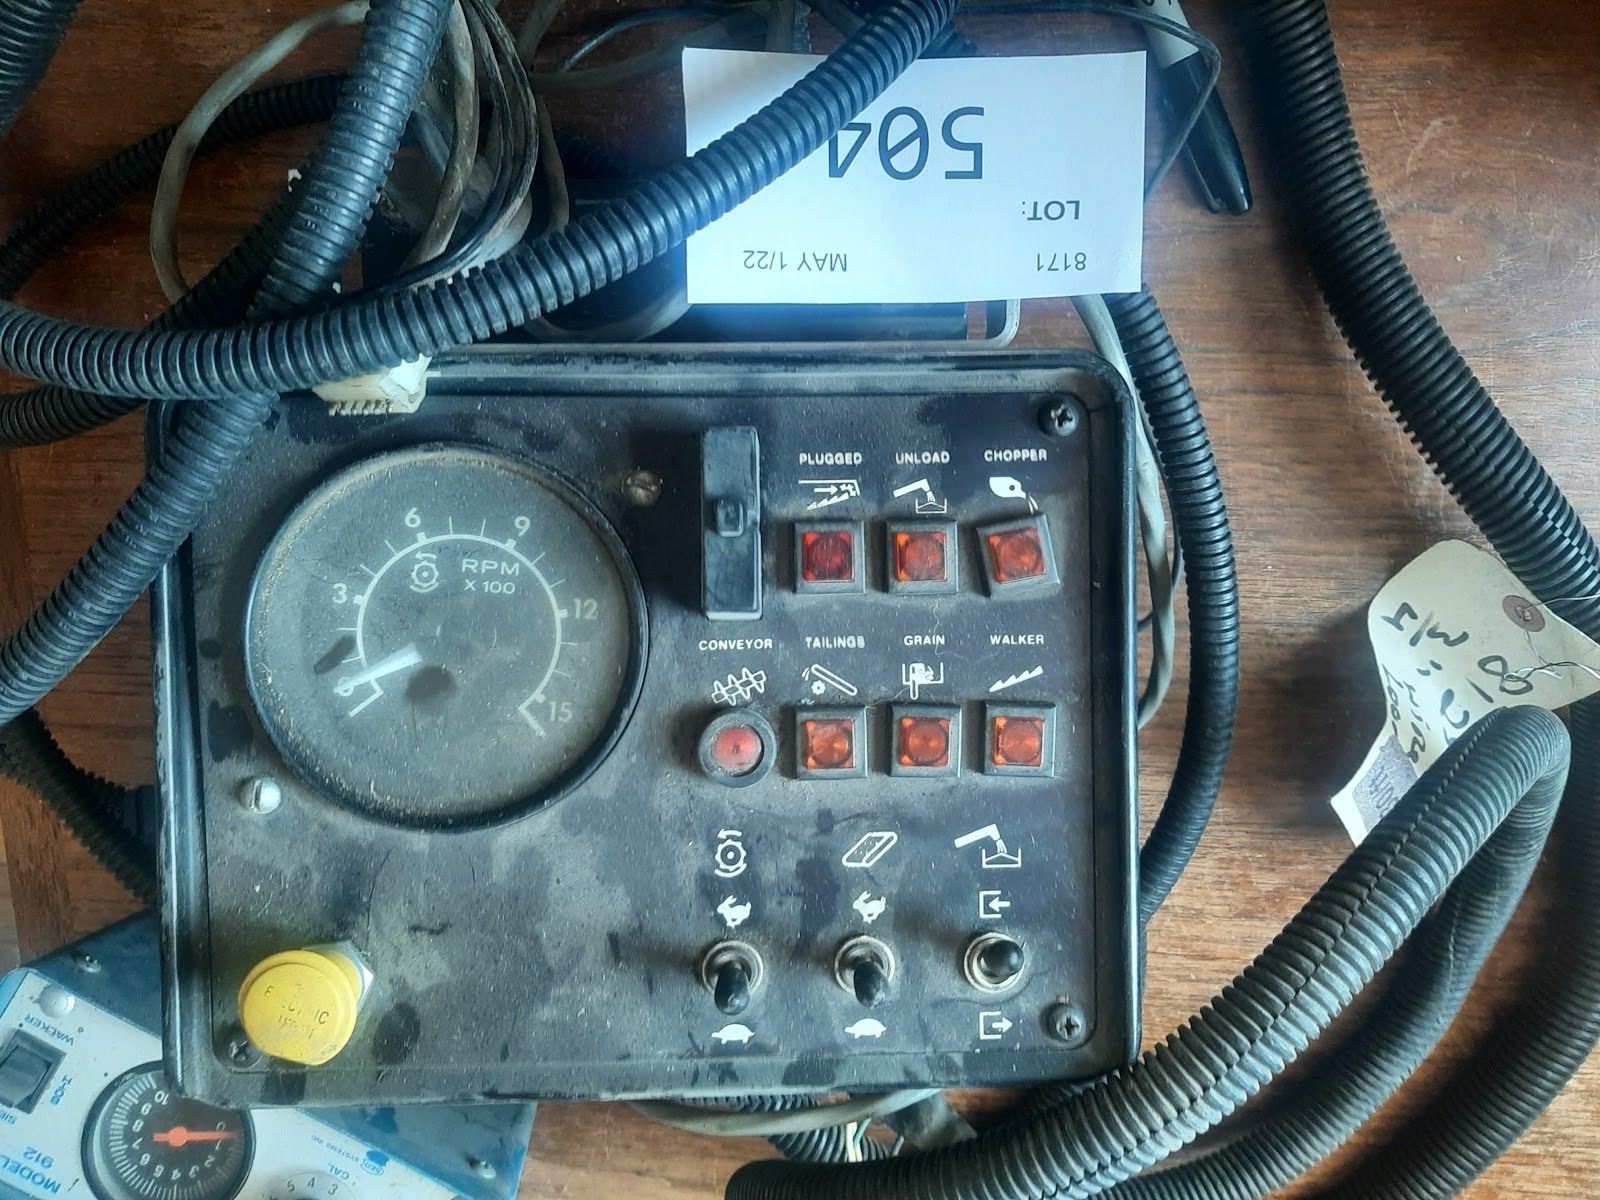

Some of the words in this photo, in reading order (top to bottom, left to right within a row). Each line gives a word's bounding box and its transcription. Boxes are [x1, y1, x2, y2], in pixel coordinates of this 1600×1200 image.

[828, 106, 985, 181] 504
[1021, 199, 1081, 220] LOT:
[742, 249, 788, 270] 1/22
[797, 251, 848, 273] MAY
[1035, 251, 1087, 271] 8171
[799, 451, 863, 465] PLUGGED
[895, 450, 950, 464] UNLOAD
[984, 448, 1048, 463] CHOPPER
[404, 507, 422, 528] 6
[514, 516, 531, 536] 9
[461, 558, 520, 576] RPM
[332, 583, 348, 604] 3
[464, 579, 477, 592] X
[482, 580, 516, 595] 100
[573, 599, 599, 619] 12
[698, 638, 774, 651] CONVEYOR
[804, 635, 866, 650] TAILINGS
[903, 634, 946, 647] GRAIN
[989, 634, 1045, 647] WALKER
[550, 703, 574, 723] 15
[22, 1013, 76, 1047] WALKER
[49, 1073, 73, 1107] BOTH
[154, 1091, 171, 1106] 10
[141, 1102, 152, 1115] 9
[132, 1121, 143, 1133] 8
[132, 1137, 144, 1150] 7
[22, 1146, 54, 1169] 912
[326, 1141, 360, 1163] SYSTEMS
[139, 1154, 151, 1166] 6
[204, 1155, 216, 1167] 2
[0, 1154, 62, 1195] MODEL
[153, 1164, 164, 1178] 5
[170, 1168, 182, 1181] 4
[188, 1165, 200, 1178] 3
[327, 1162, 350, 1180] CAL
[286, 1179, 296, 1193] 5
[307, 1176, 316, 1189] 4
[328, 1183, 338, 1196] 3
